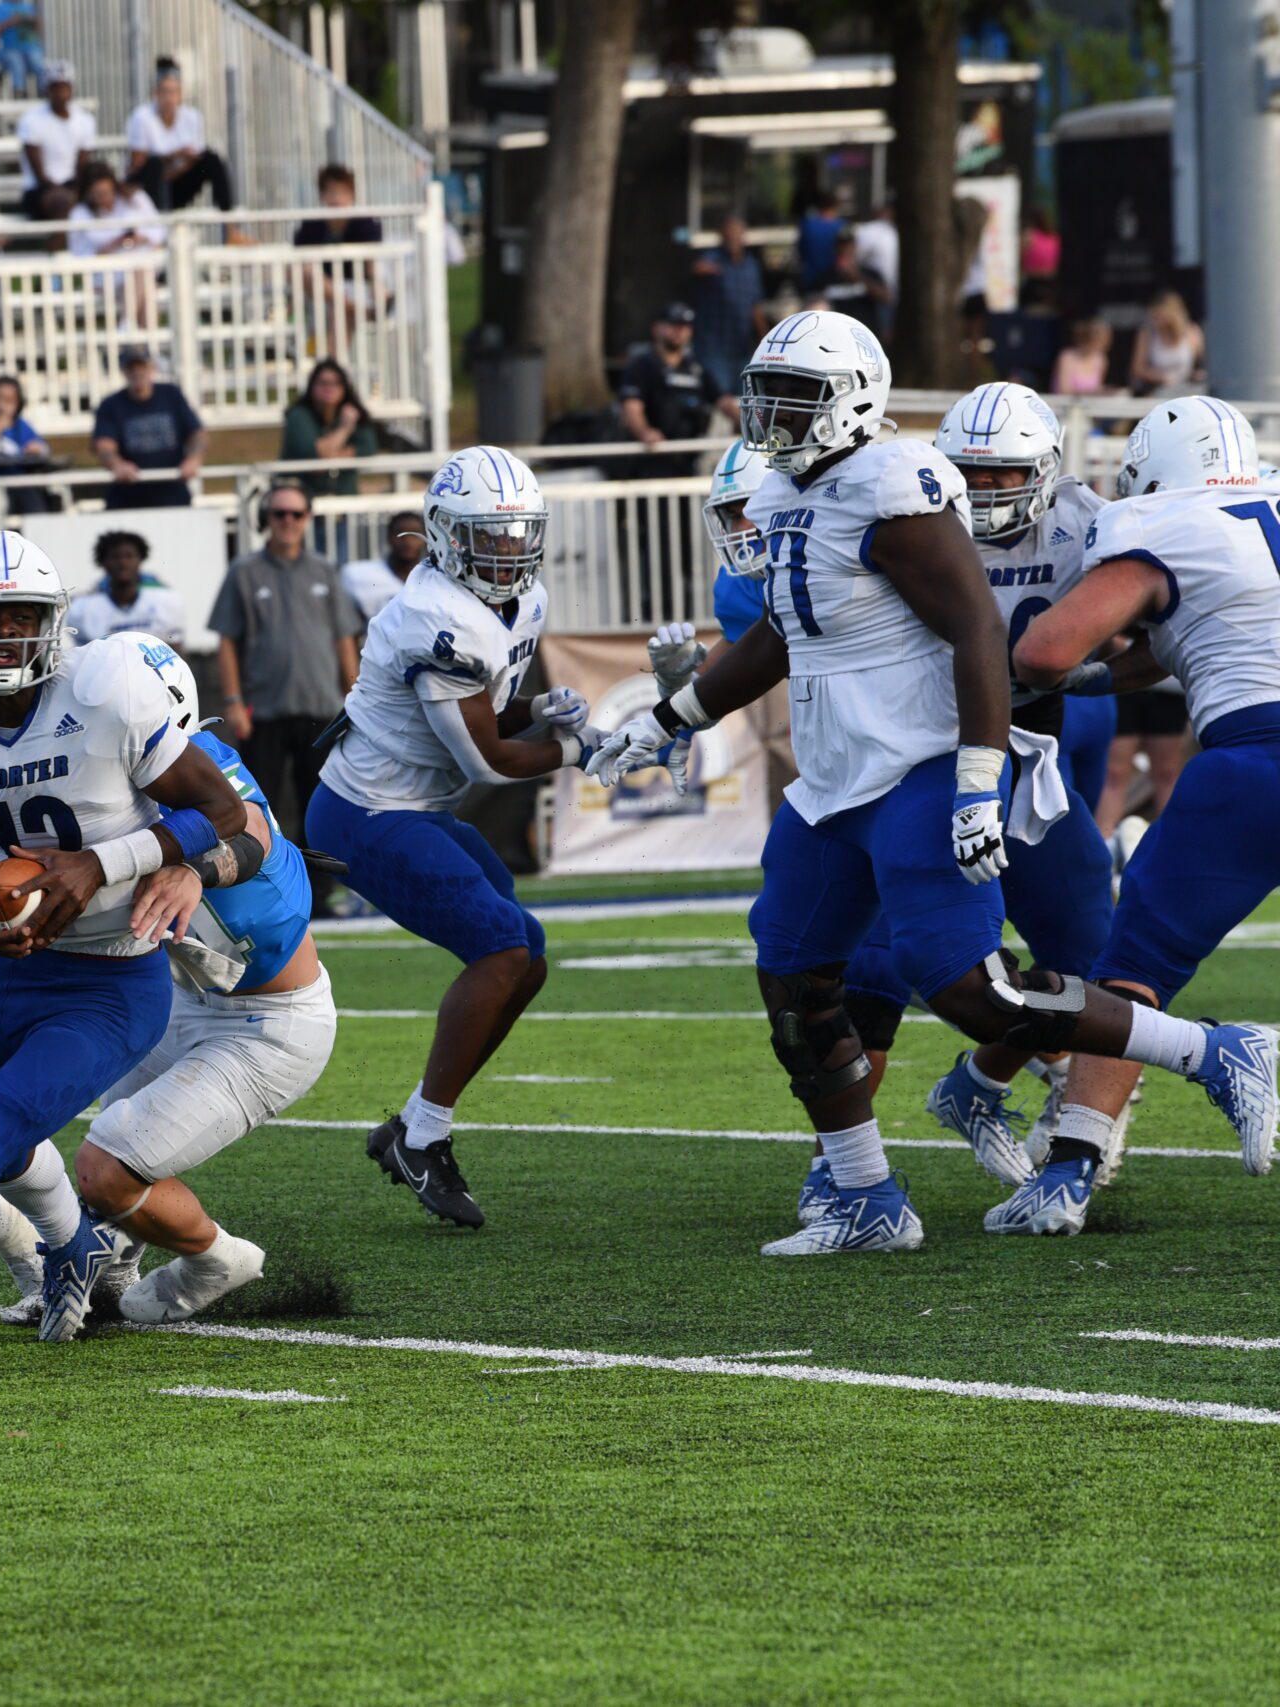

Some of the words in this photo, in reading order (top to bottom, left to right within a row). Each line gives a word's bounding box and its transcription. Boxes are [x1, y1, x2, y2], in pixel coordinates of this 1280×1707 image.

[774, 456, 792, 464] Riddell
[1218, 500, 1280, 580] 7
[985, 564, 1054, 587] ORTER
[54, 724, 84, 738] adidas
